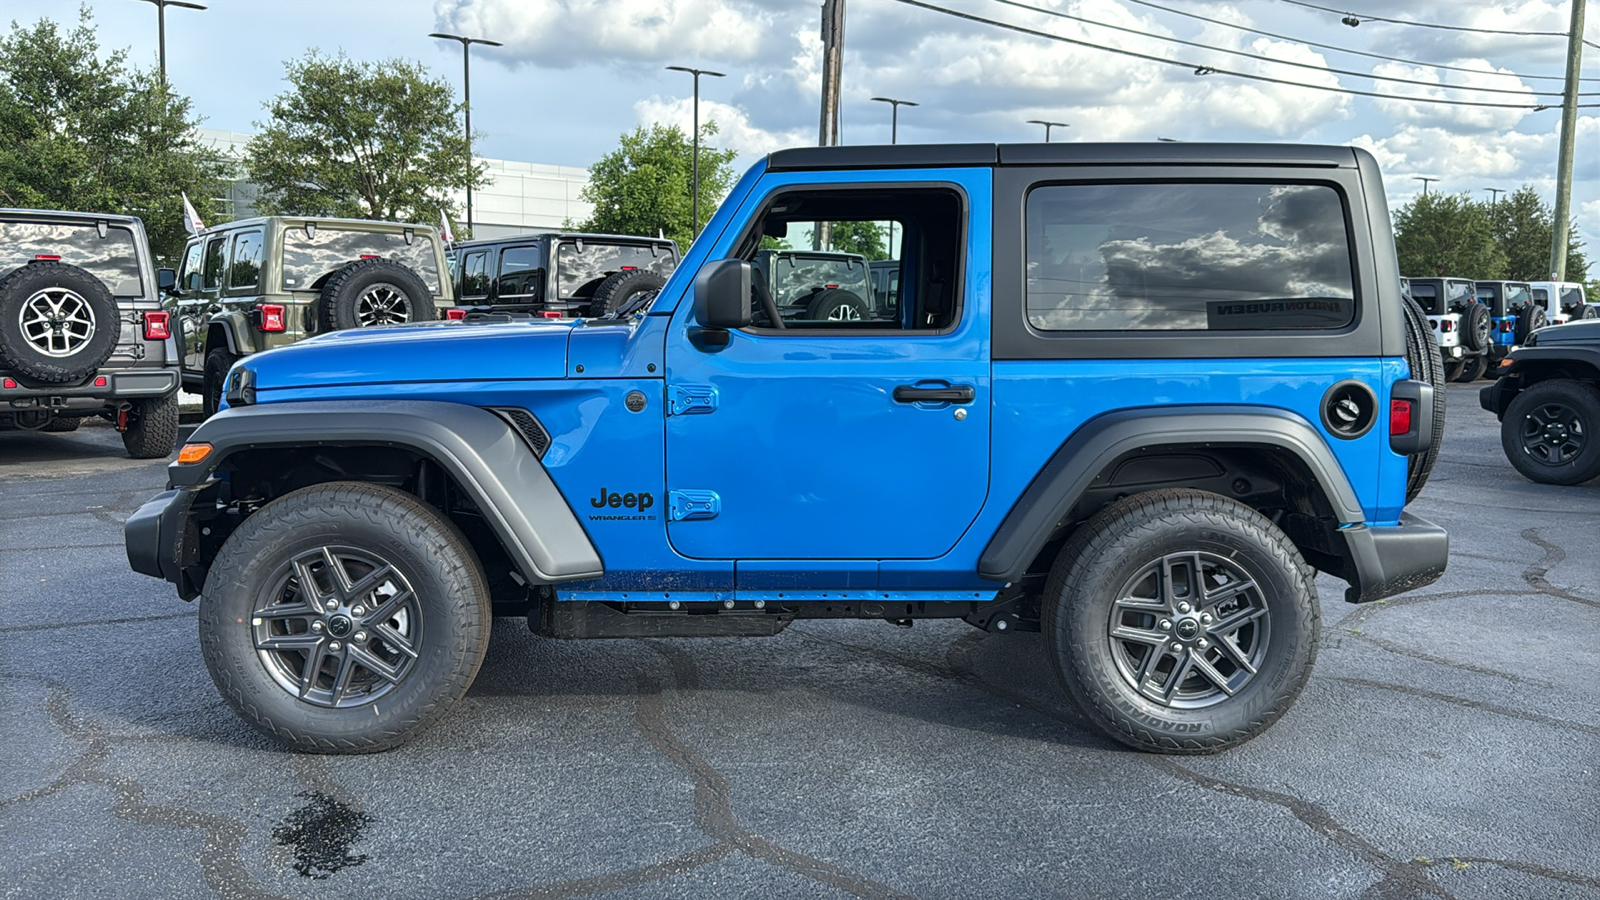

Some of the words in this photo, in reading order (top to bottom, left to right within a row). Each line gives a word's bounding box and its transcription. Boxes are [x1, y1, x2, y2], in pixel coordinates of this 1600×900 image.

[591, 487, 653, 511] Jeep
[232, 654, 260, 696] 245/75R17
[1118, 699, 1202, 732] ROADIAN
